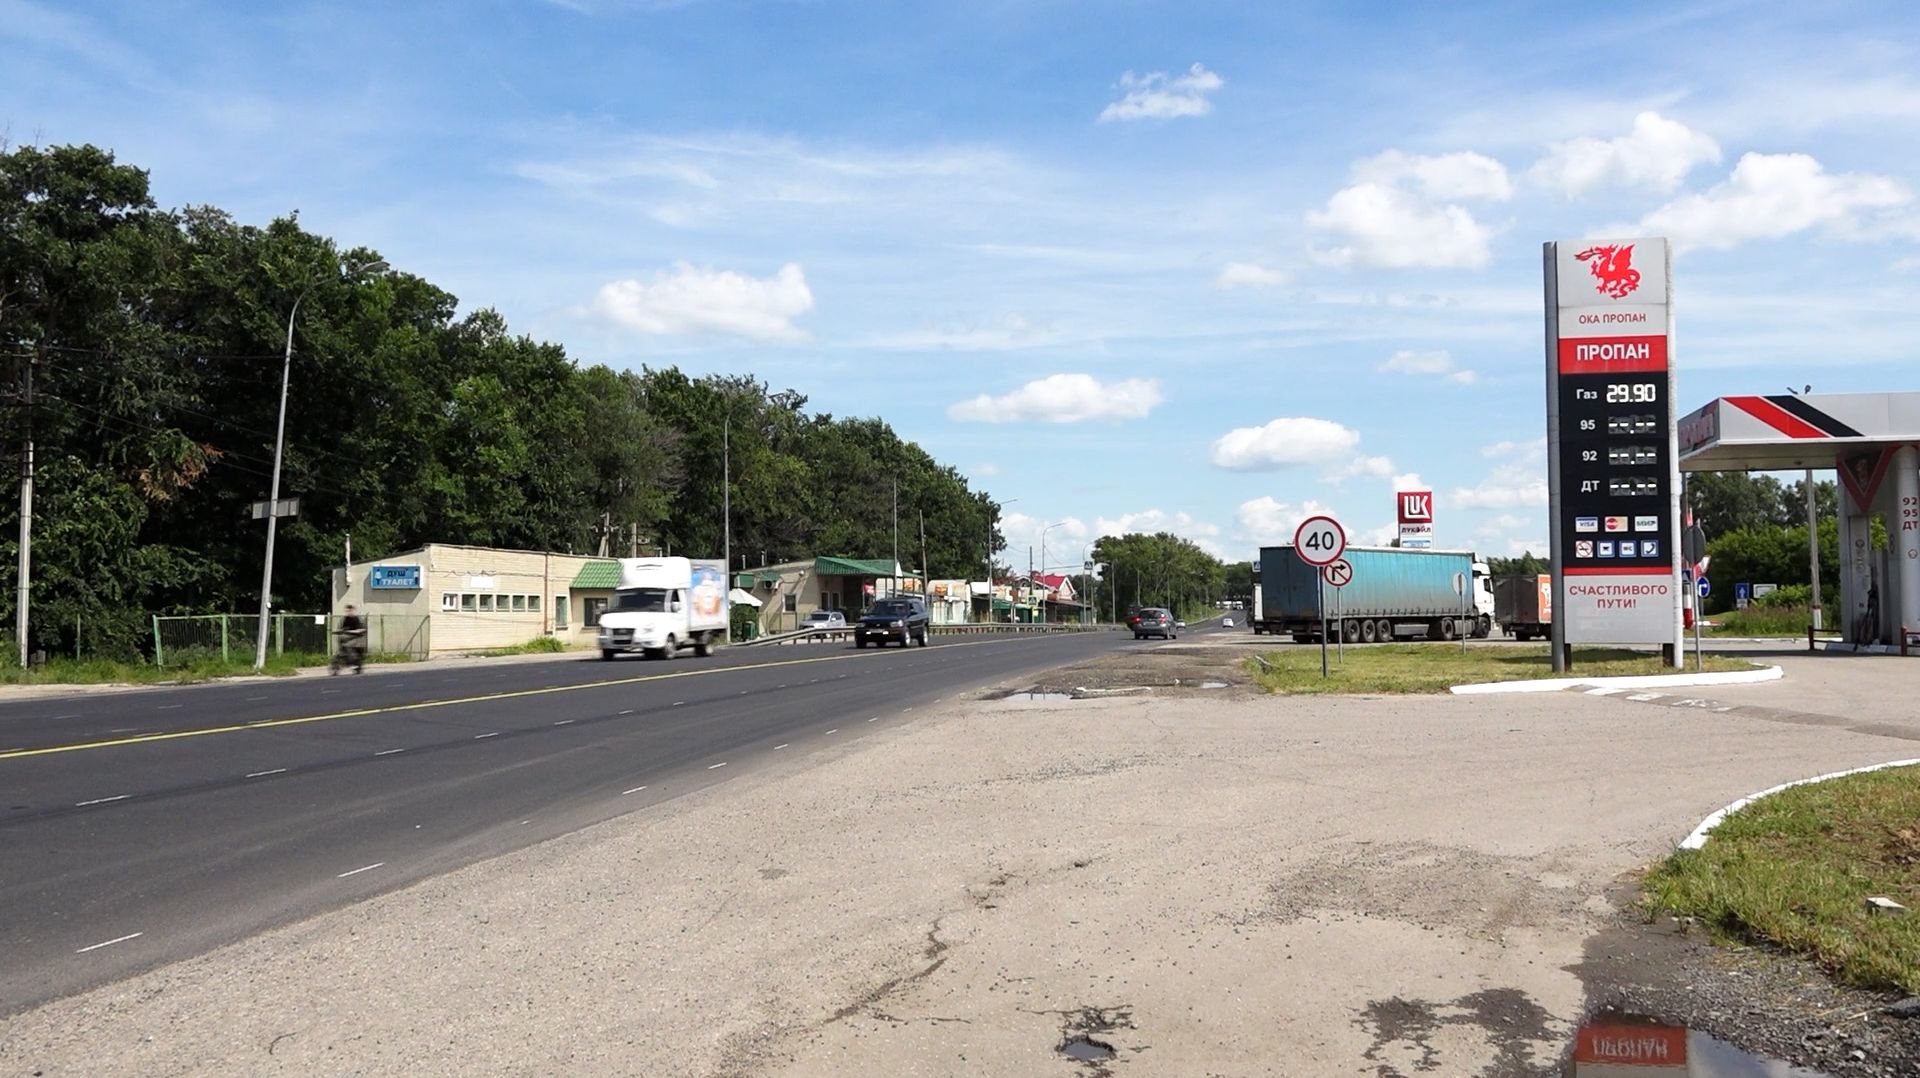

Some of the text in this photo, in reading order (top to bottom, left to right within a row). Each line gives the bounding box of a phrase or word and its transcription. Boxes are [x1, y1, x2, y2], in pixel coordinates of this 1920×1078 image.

[1579, 313, 1647, 324] ОКА ПРОПАН
[1576, 343, 1650, 361] ПРОПАН
[1576, 383, 1656, 403] Газ 29.90
[1580, 419, 1596, 430] 95
[1582, 450, 1598, 461] 92
[1581, 480, 1600, 492] ДТ
[1902, 496, 1918, 505] 92
[1903, 508, 1918, 517] 95
[1902, 520, 1919, 530] ДТ
[1305, 531, 1335, 551] 40
[381, 578, 414, 586] ТУАЛЕТ
[1569, 585, 1668, 596] СЧАСТЛИВОГО
[1597, 598, 1637, 609] ПУТИ!
